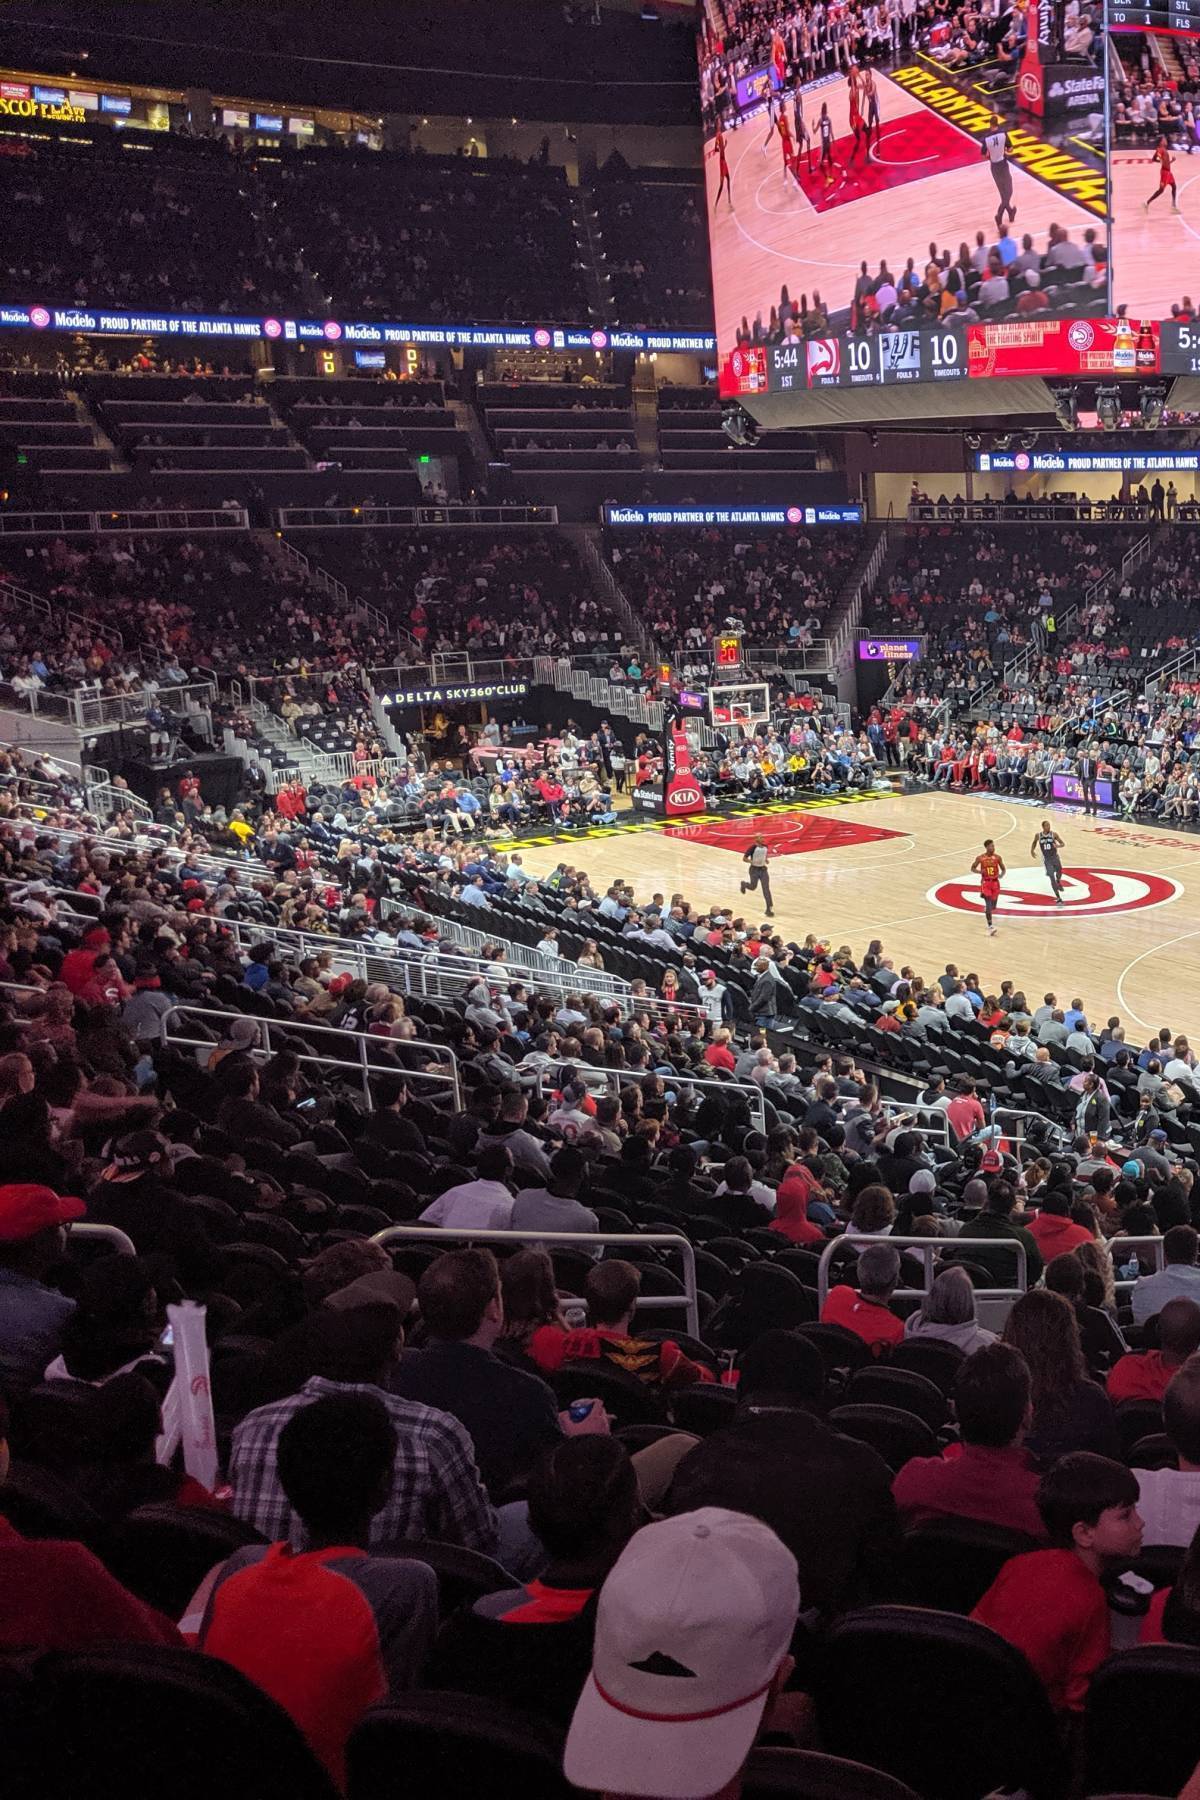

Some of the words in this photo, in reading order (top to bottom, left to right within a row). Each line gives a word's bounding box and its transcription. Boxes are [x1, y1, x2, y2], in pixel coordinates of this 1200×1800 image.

[1176, 1, 1190, 11] STL
[1114, 13, 1125, 22] TO
[1145, 14, 1151, 24] 1
[1176, 19, 1190, 29] FLS
[1064, 76, 1104, 94] StateFa
[889, 66, 1006, 132] ATLANTA
[55, 312, 96, 327] Modelo
[100, 317, 129, 329] PROUD
[130, 318, 167, 330] PARTNER
[168, 320, 179, 331] OF
[181, 320, 197, 332] THE
[199, 321, 232, 333] ATLANTA
[233, 323, 260, 335] HAWKS
[345, 326, 381, 339] Modelo
[384, 329, 410, 340] PROUD
[411, 330, 445, 341] PARTNER
[445, 331, 455, 342] OF
[456, 332, 471, 342] THE
[472, 332, 504, 343] ATLANTA
[505, 333, 531, 344] HAWKS
[610, 335, 643, 347] Modelo
[647, 337, 671, 347] PROUD
[672, 338, 703, 348] PARTNER
[704, 338, 714, 348] OF
[848, 342, 870, 370] 10
[930, 335, 957, 366] 10
[774, 349, 797, 369] 5:44
[934, 369, 960, 377] TIMEOUTS
[782, 375, 792, 387] 1ST
[1033, 456, 1064, 468] Modelo
[1068, 458, 1091, 468] PROUD
[1092, 457, 1122, 468] PARTNER
[1122, 457, 1131, 468] OF
[1132, 457, 1145, 468] THE
[1146, 457, 1174, 468] ATLANTA
[1174, 457, 1198, 468] HAWKS
[611, 510, 644, 522] Modelo
[647, 512, 672, 522] PROUD
[673, 512, 704, 522] PARTNER
[705, 512, 714, 522] OF
[715, 512, 730, 521] THE
[730, 512, 760, 521] ATLANTA
[760, 512, 784, 521] HAWKS
[880, 644, 907, 652] planet
[721, 649, 735, 662] 20
[396, 691, 441, 703] DELTA
[675, 792, 694, 803] KIA
[494, 814, 728, 853] ATLANTA
[987, 867, 994, 875] 12
